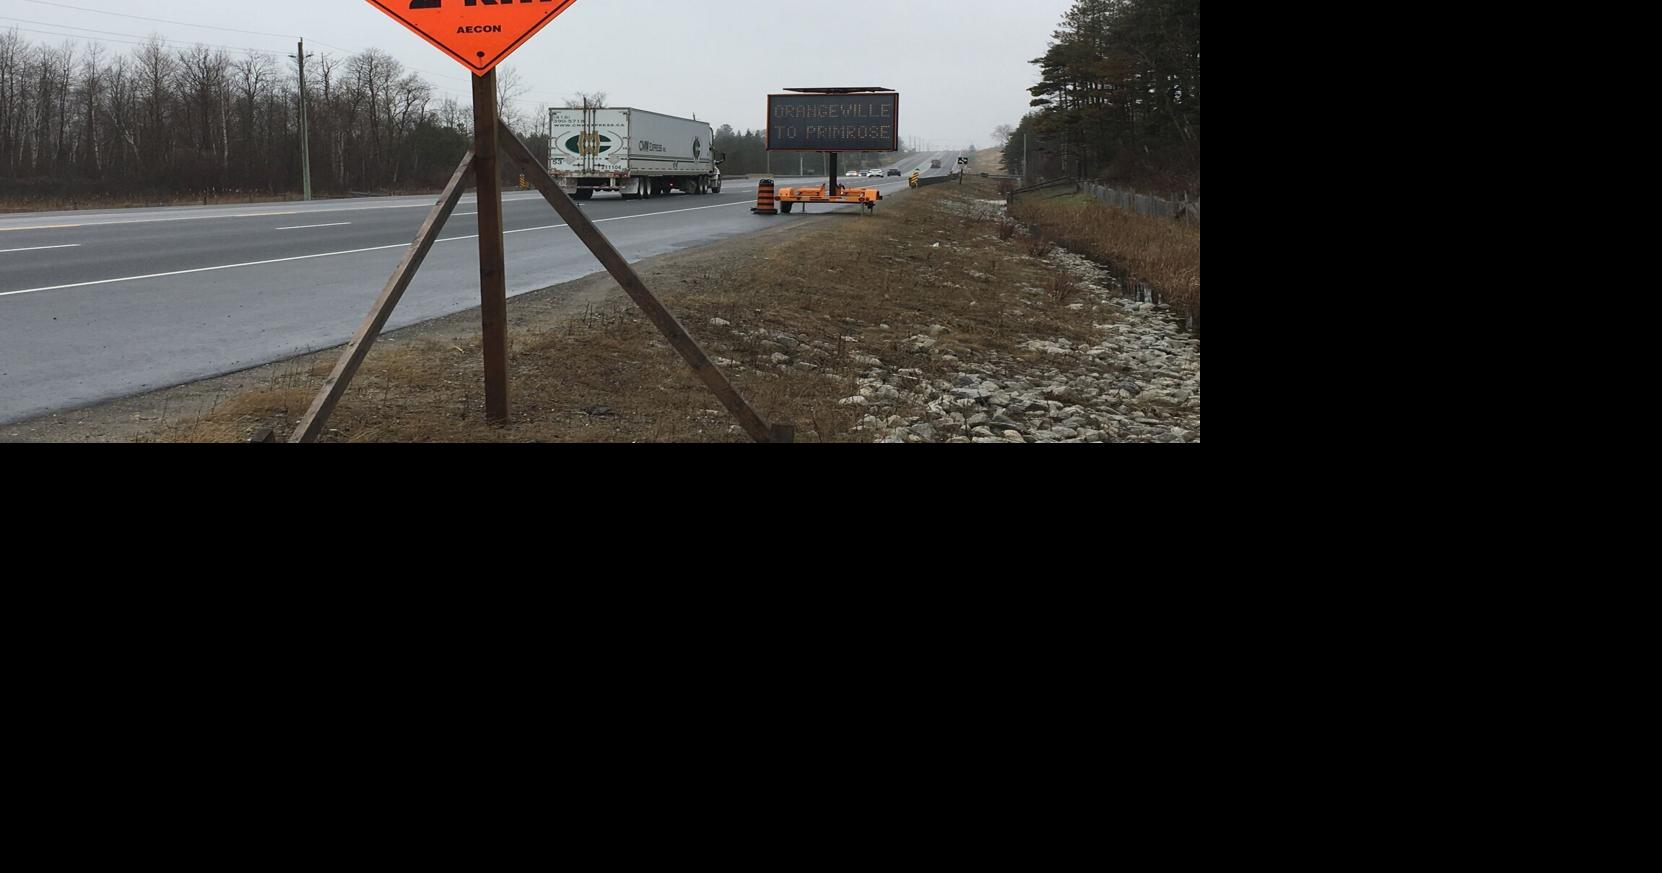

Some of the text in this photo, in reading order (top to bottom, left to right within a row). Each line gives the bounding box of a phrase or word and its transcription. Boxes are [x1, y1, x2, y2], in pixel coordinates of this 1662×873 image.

[456, 25, 502, 34] AECON
[774, 103, 891, 118] ORANGEVILLE
[774, 125, 891, 139] TO PRIMROSE
